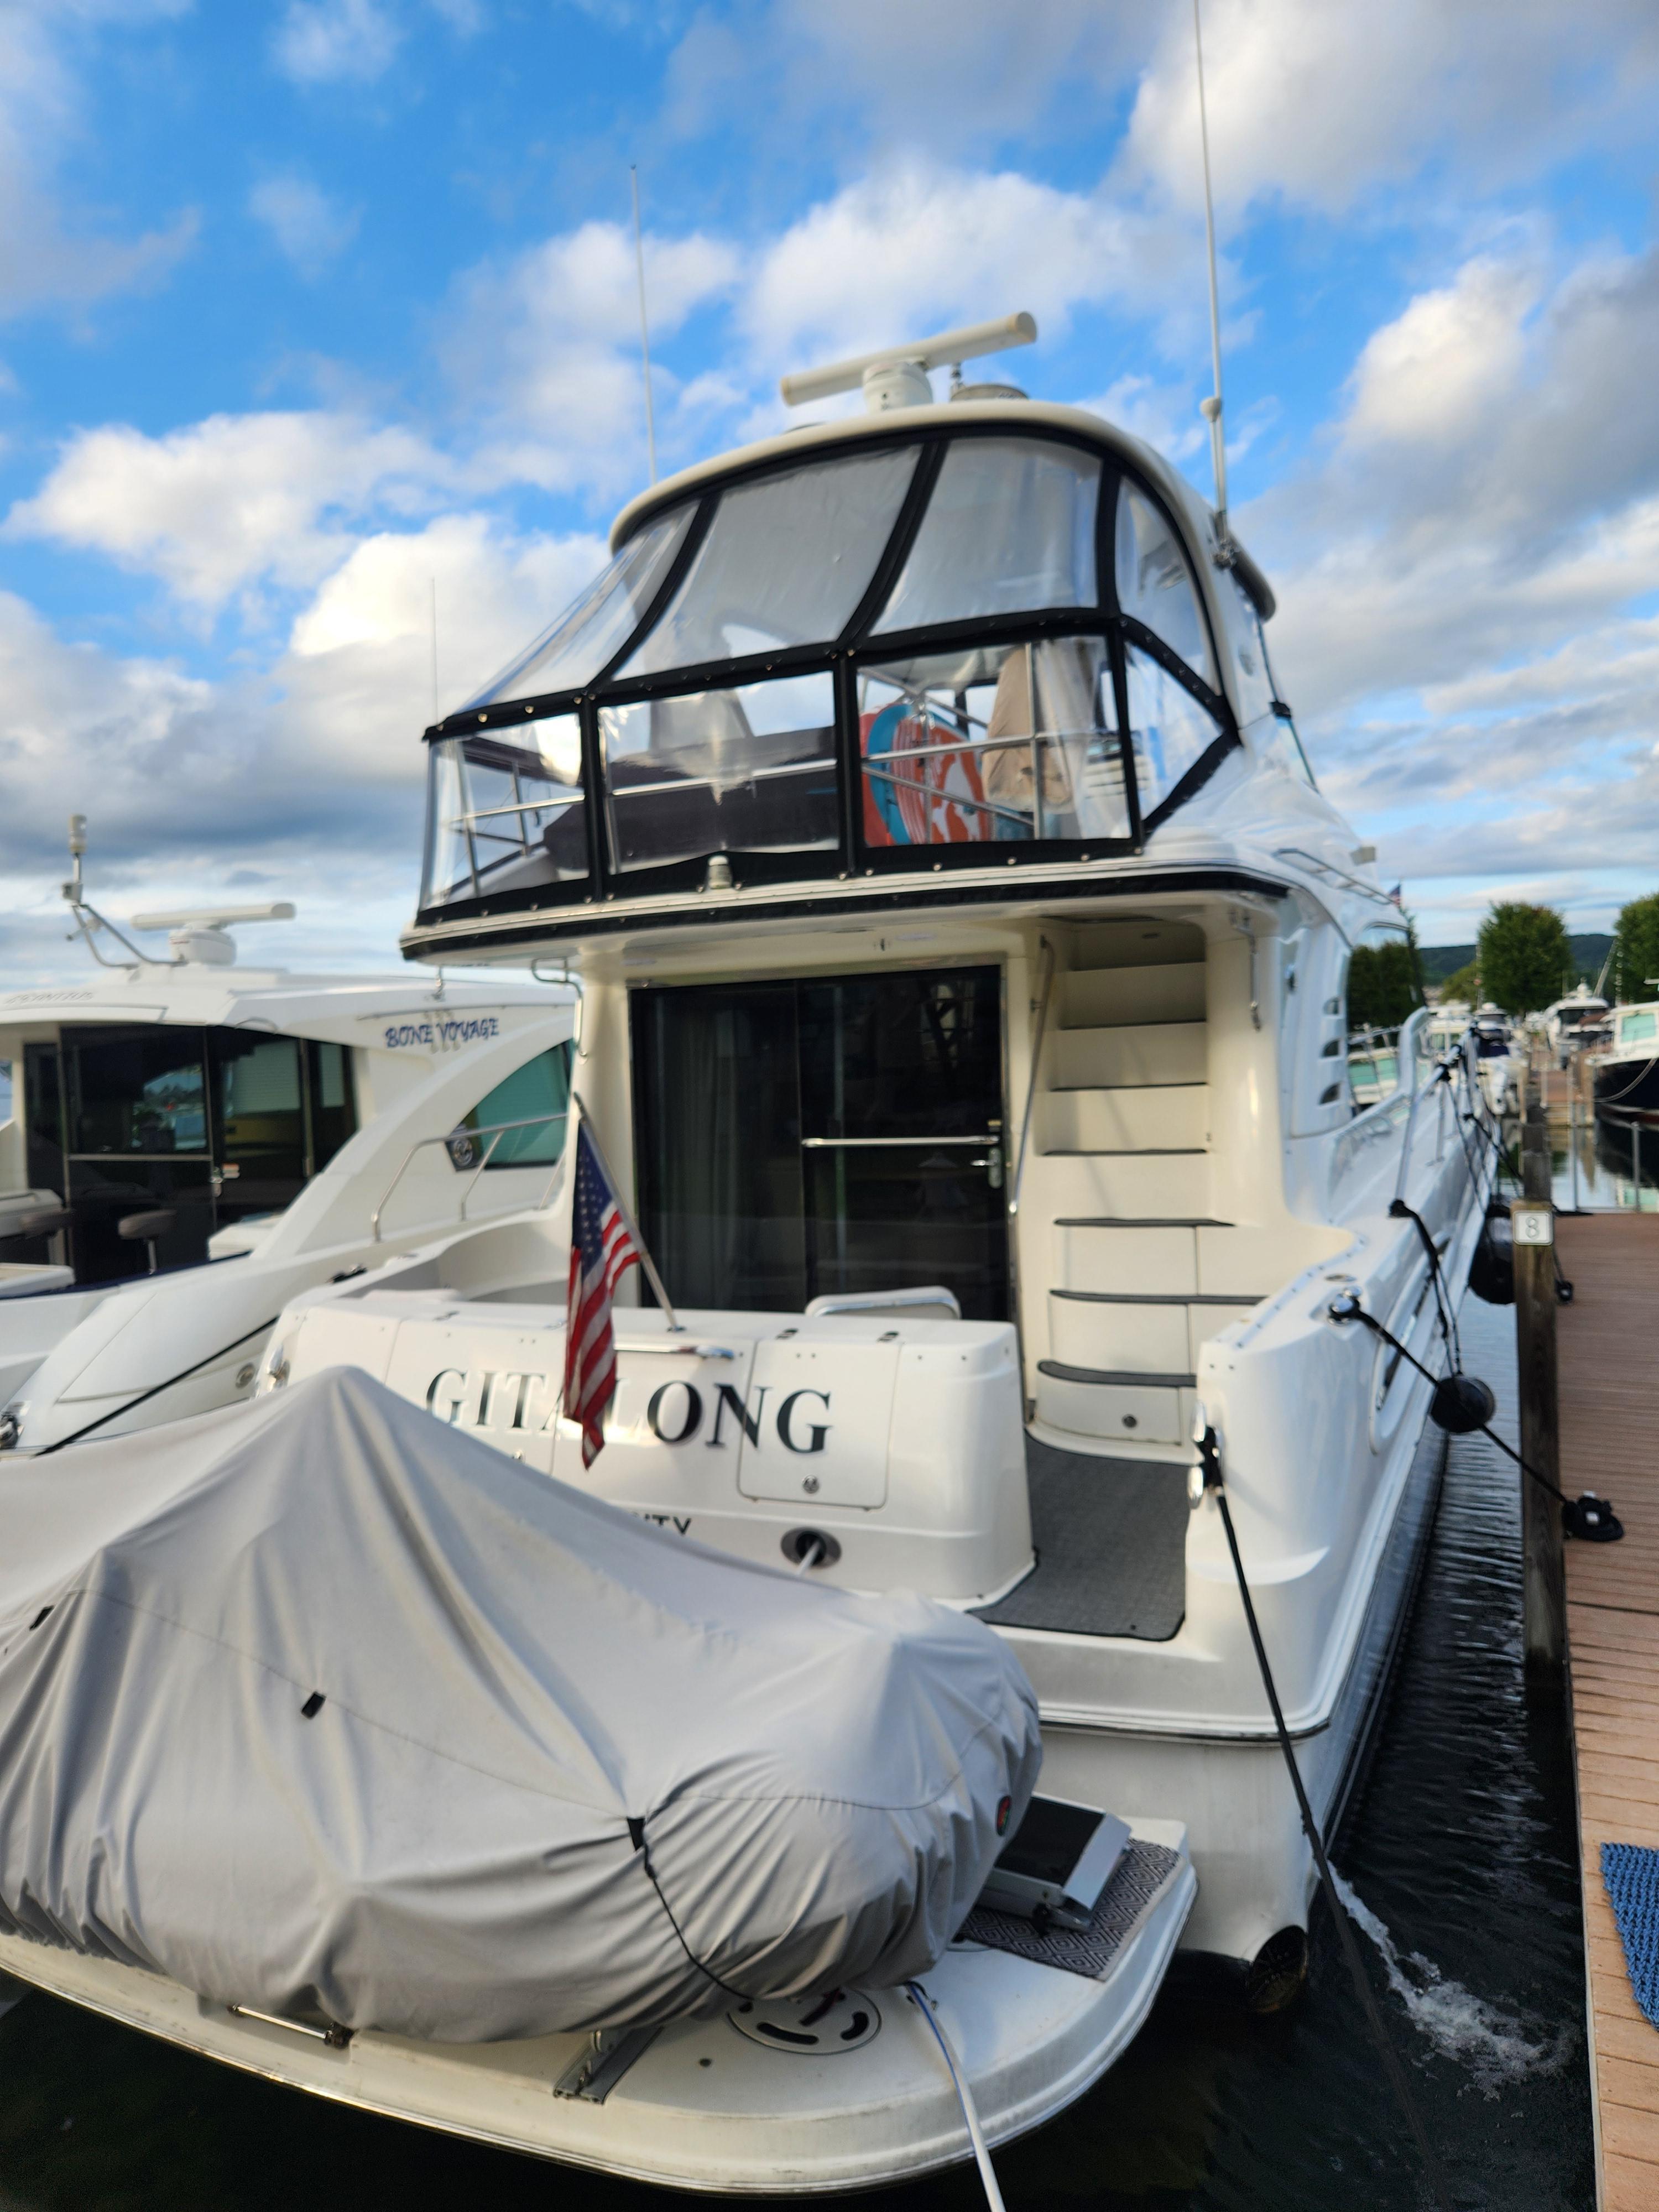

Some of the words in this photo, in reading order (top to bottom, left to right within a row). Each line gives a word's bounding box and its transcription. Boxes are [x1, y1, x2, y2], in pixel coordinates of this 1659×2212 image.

[385, 1025, 433, 1047] BONE
[436, 1018, 499, 1042] VOYAGE
[1526, 1217, 1540, 1239] 8
[426, 1368, 833, 1453] GITLONG
